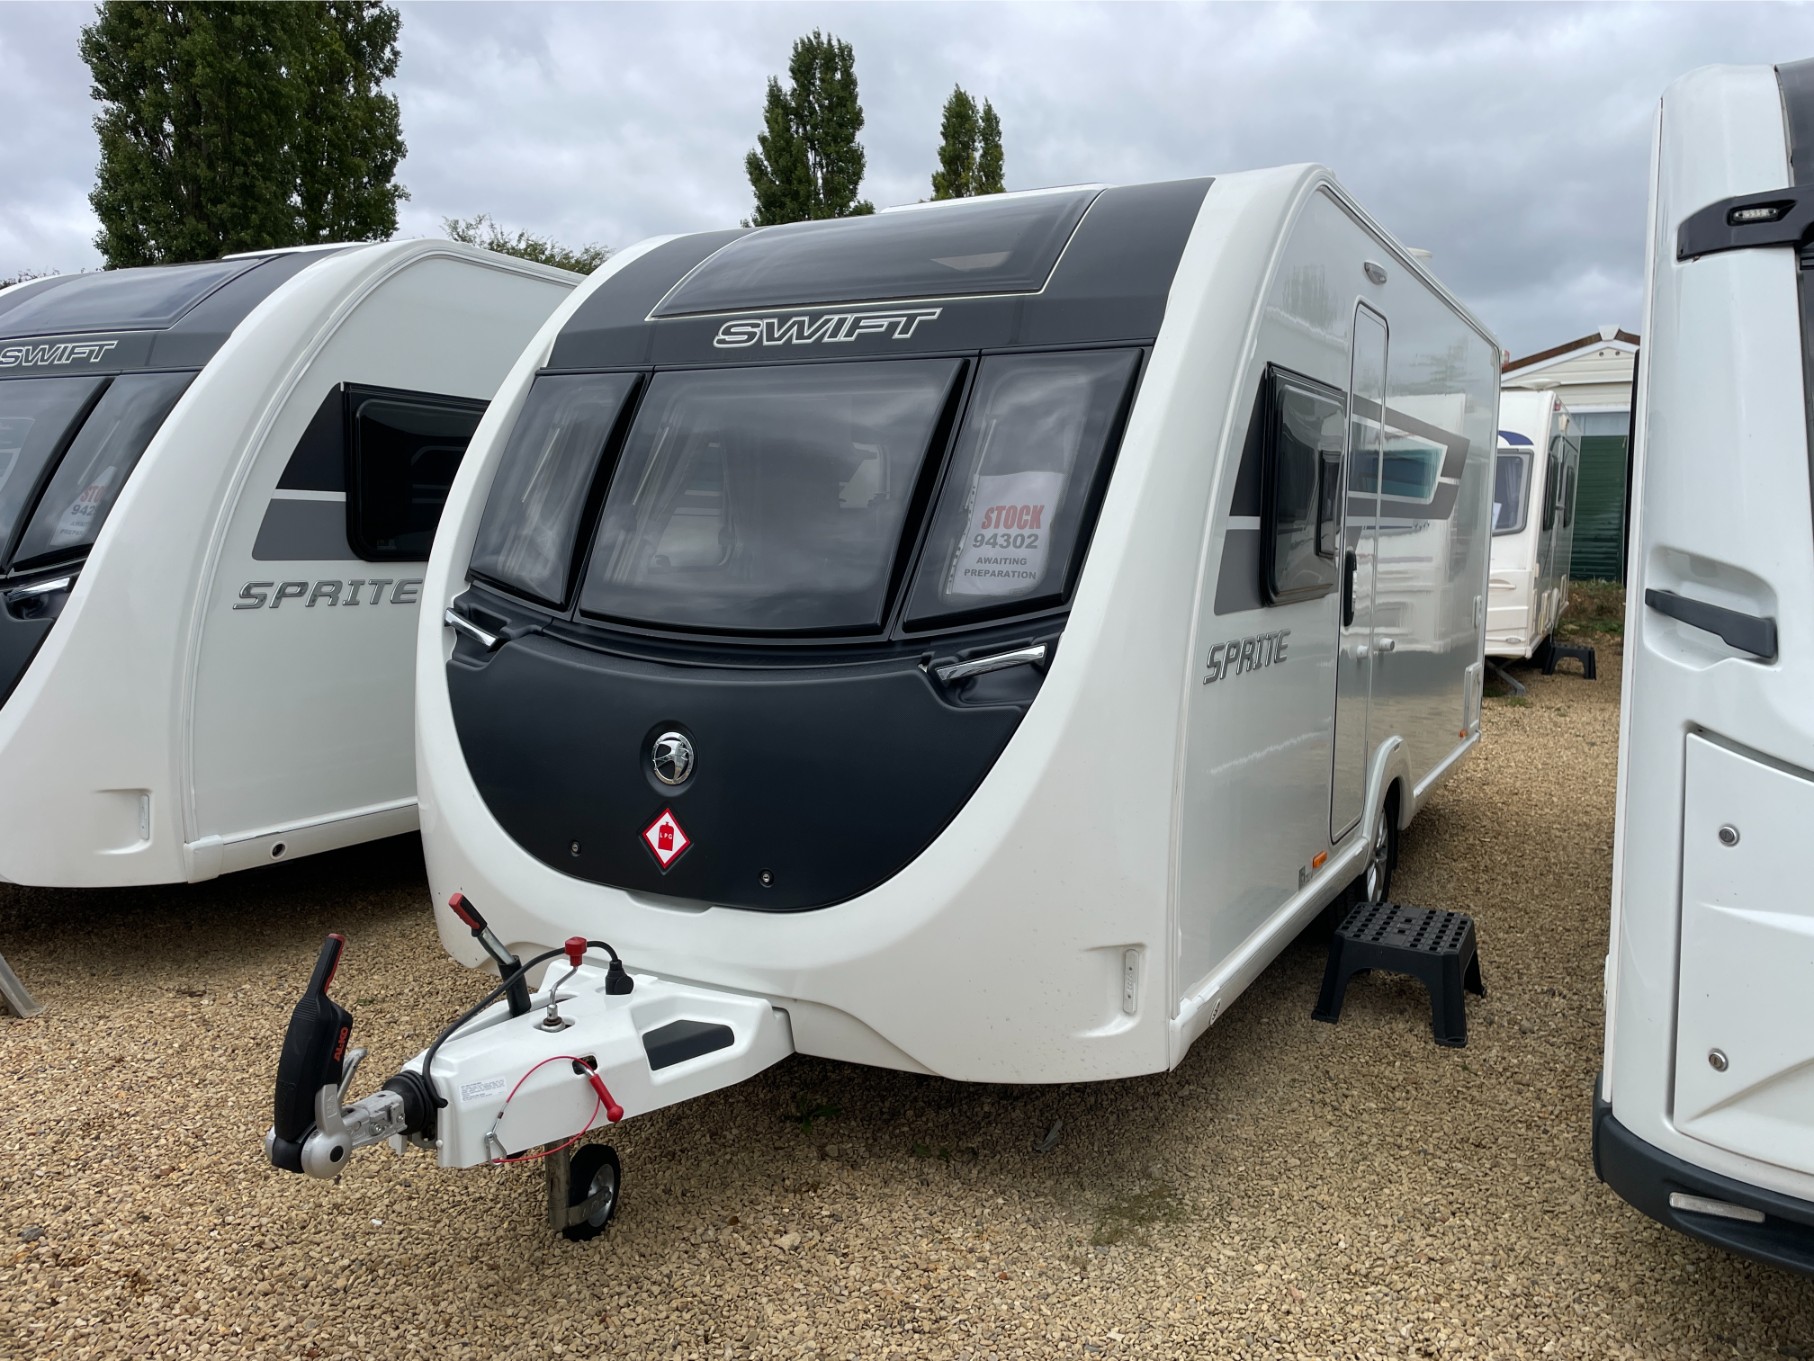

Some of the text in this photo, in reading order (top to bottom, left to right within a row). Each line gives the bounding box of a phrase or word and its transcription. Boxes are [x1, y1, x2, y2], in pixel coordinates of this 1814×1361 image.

[713, 307, 943, 348] SWIFT
[0, 340, 119, 367] SWIFT
[981, 504, 1045, 530] STOCK
[972, 533, 1039, 549] 94302
[964, 568, 1037, 580] PREPARATION
[976, 557, 1027, 565] AWAITING
[232, 578, 424, 610] SPRITE
[1203, 628, 1291, 685] SPRITE
